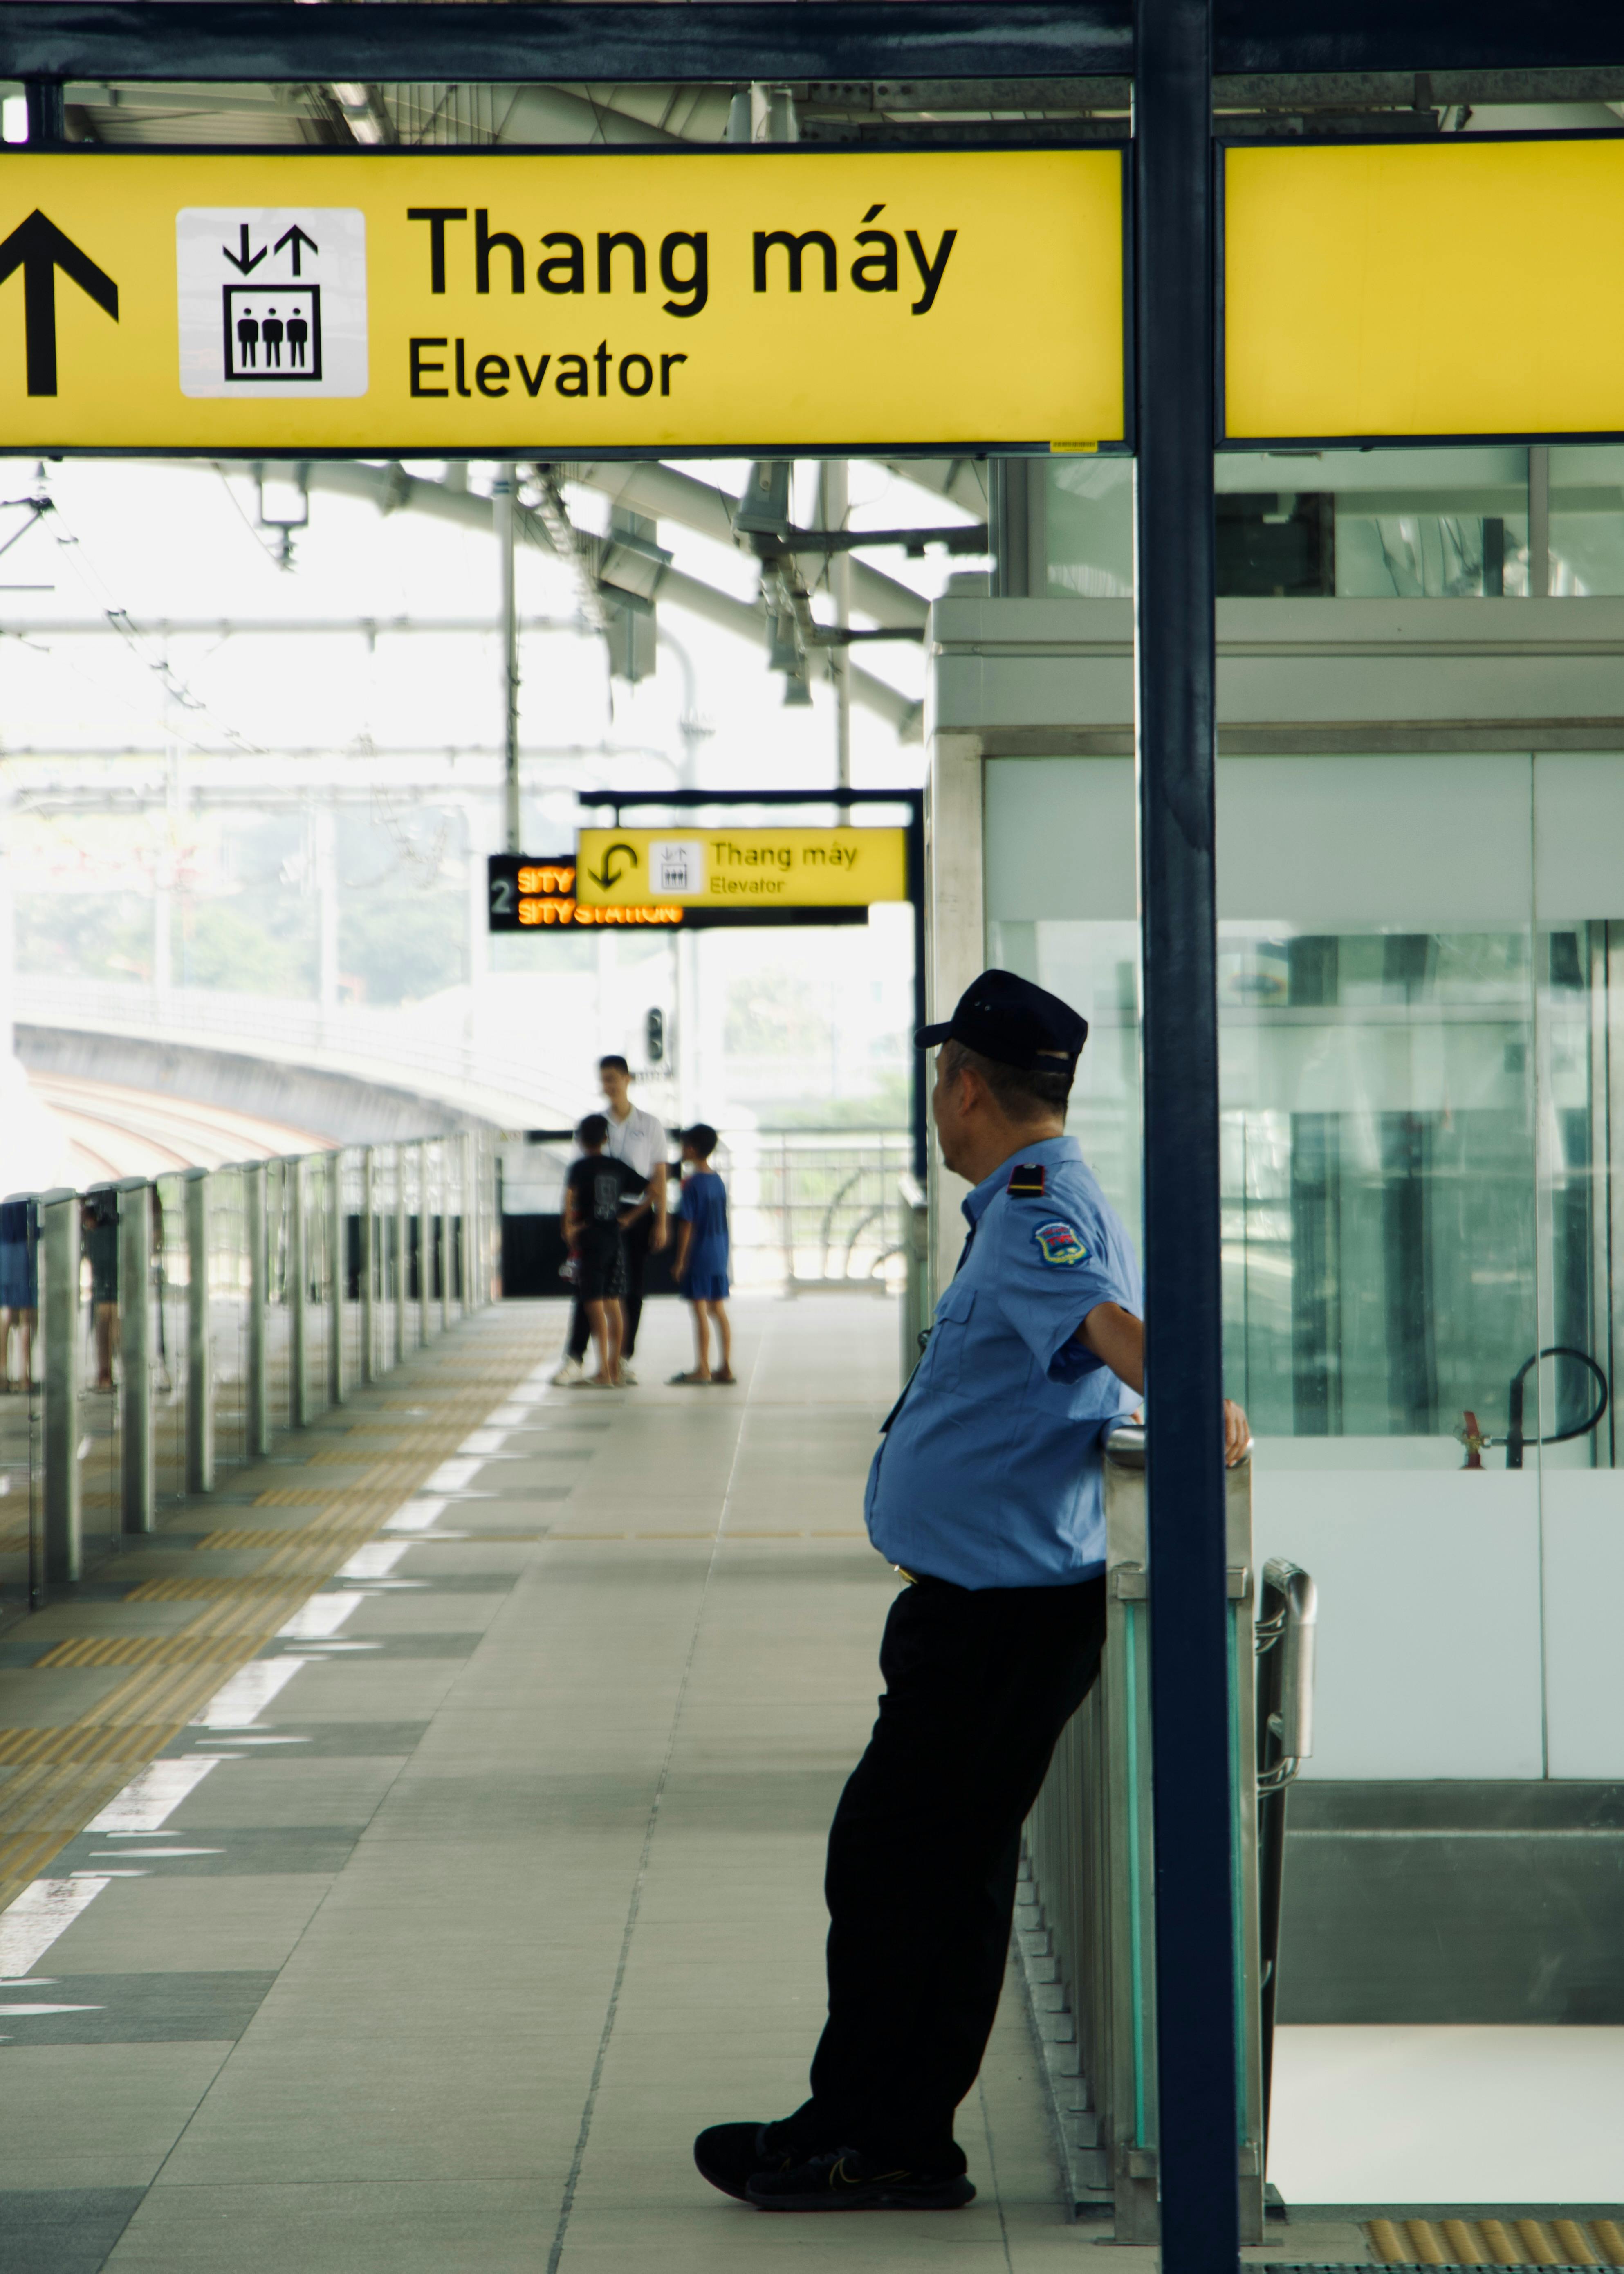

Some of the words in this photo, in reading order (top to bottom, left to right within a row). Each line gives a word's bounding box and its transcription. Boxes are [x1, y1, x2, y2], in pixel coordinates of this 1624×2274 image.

[407, 208, 709, 318] Thang
[753, 204, 958, 316] máy
[409, 337, 688, 398] Elevator
[711, 841, 792, 871] Thang
[802, 840, 858, 871] máy
[491, 880, 511, 914] 2
[711, 877, 785, 894] Elevator
